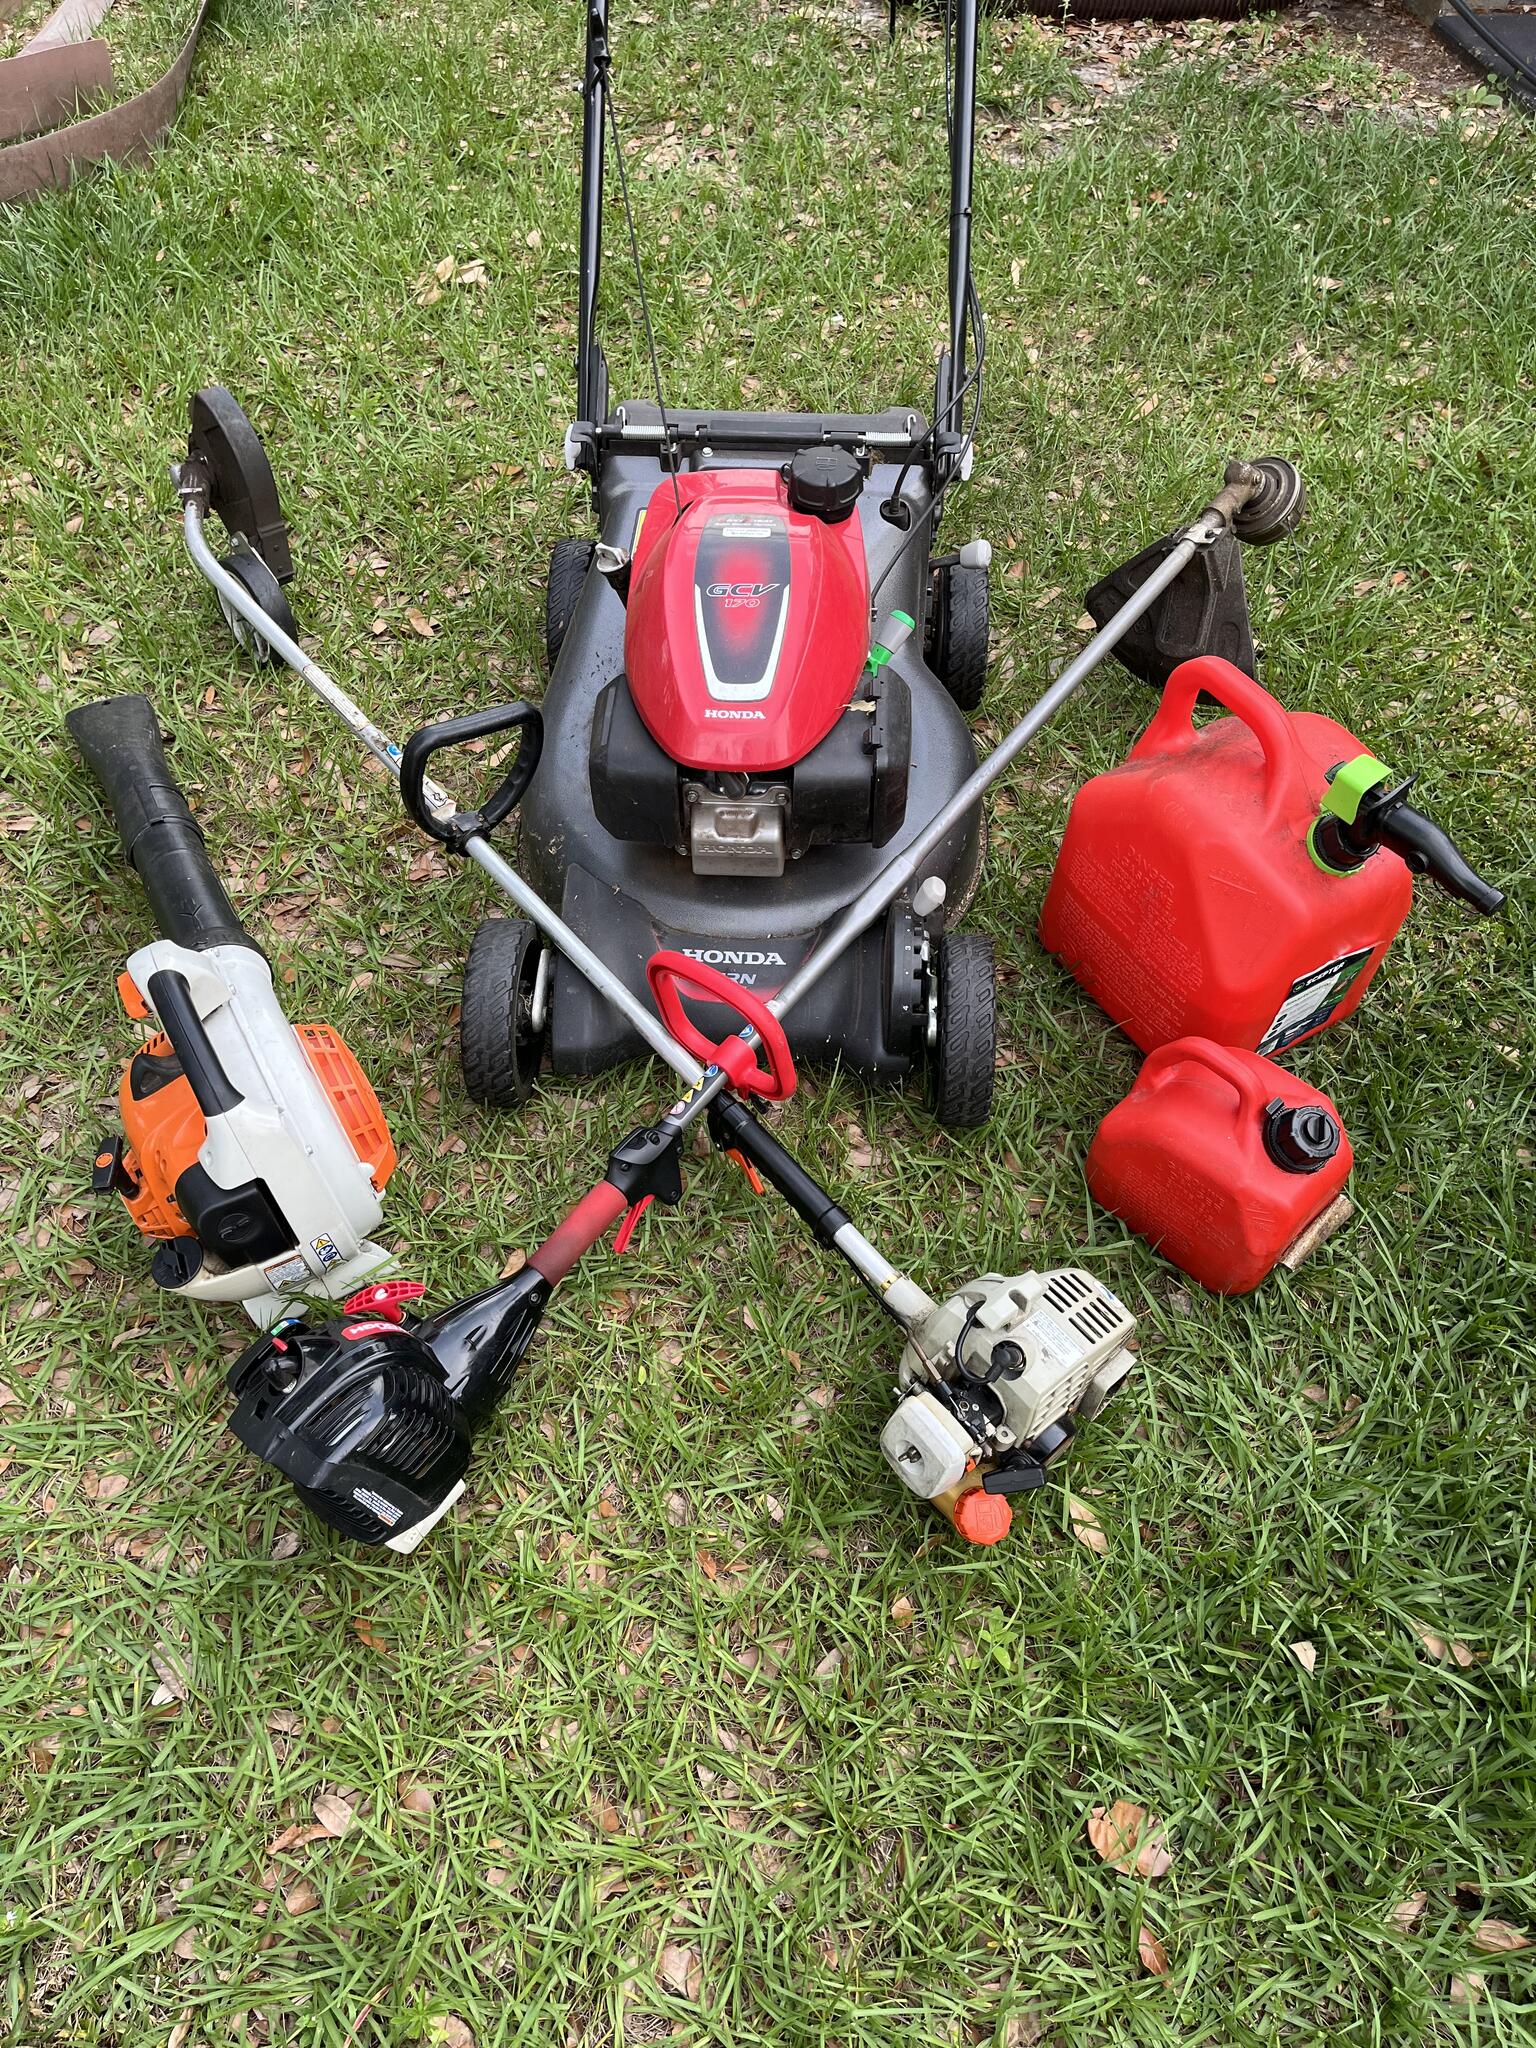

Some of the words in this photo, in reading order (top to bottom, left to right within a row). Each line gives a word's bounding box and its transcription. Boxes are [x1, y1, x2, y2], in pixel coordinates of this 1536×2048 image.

[706, 583, 780, 597] GCV
[724, 598, 761, 608] 170
[704, 709, 766, 719] HONDA
[682, 948, 787, 965] HONDA
[720, 972, 757, 985] RN
